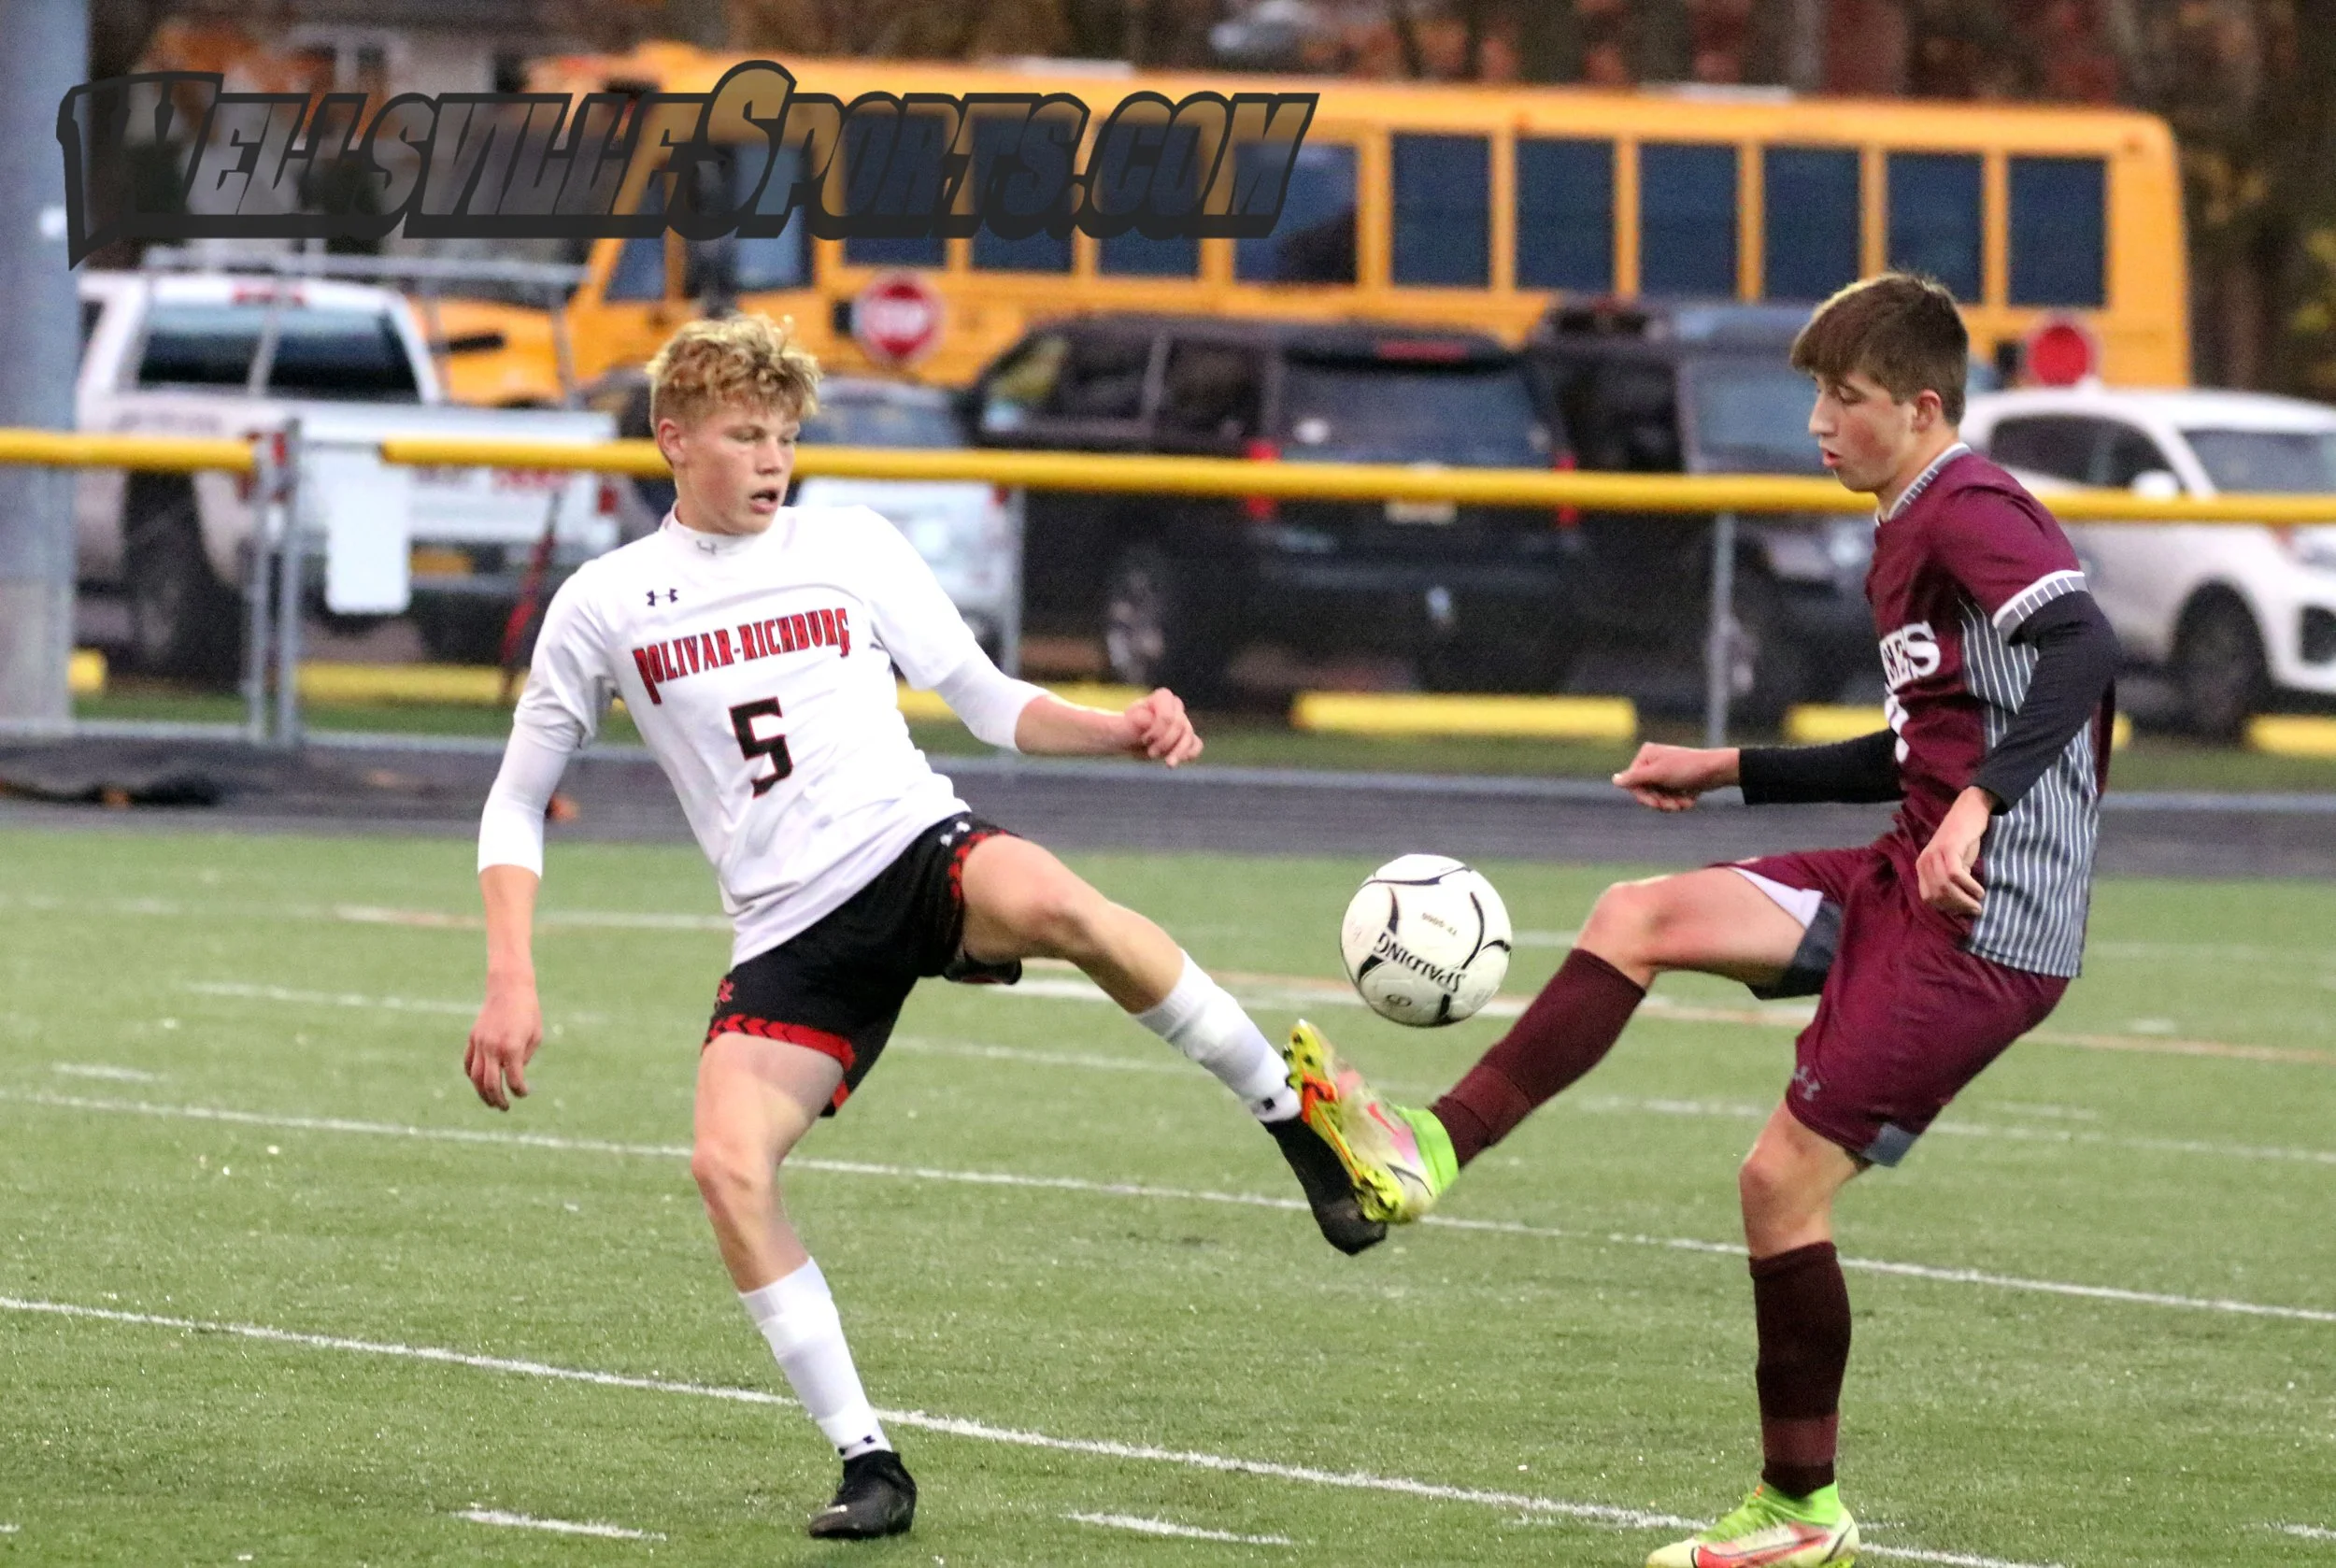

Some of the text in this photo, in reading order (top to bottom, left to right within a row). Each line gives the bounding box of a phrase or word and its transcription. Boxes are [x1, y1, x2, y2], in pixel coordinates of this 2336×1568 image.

[632, 607, 851, 705] BOLIVAR-RICHBURG
[728, 696, 793, 800] 5
[1374, 932, 1468, 993] SPALDING
